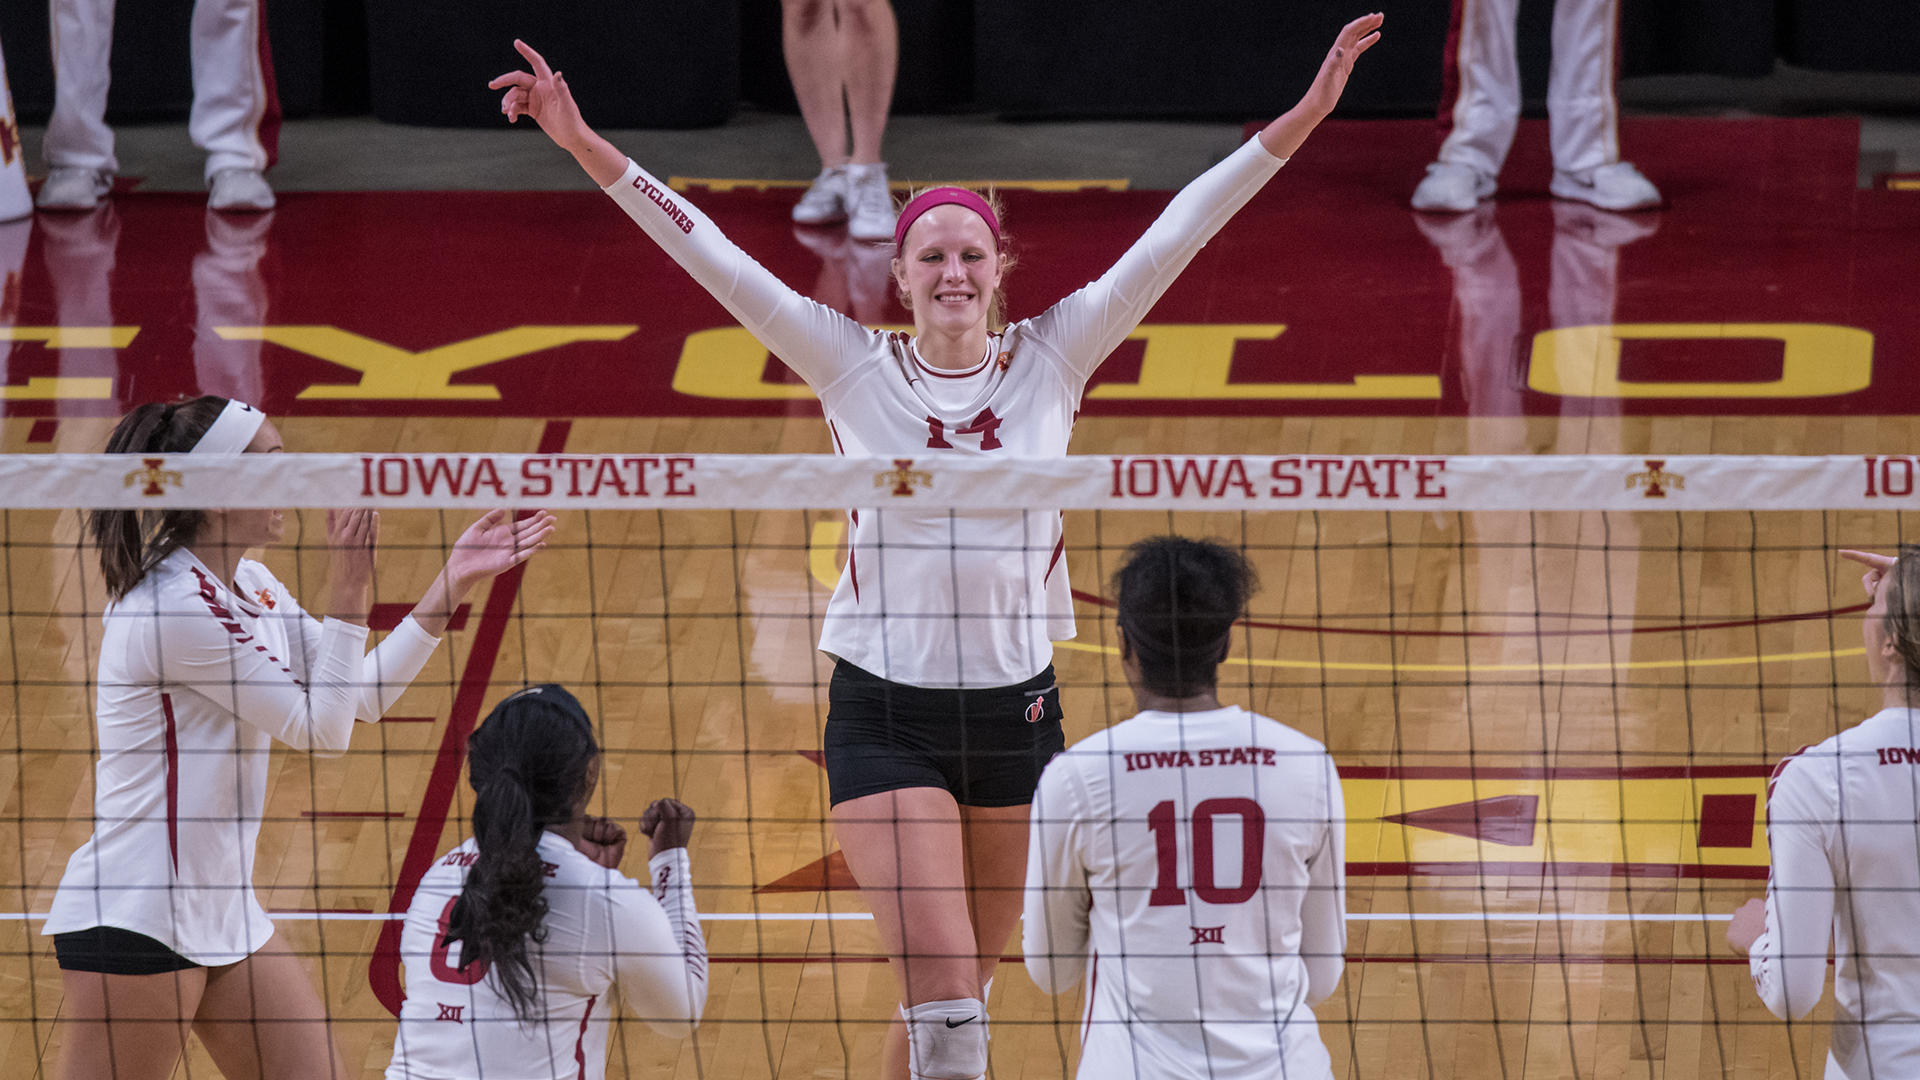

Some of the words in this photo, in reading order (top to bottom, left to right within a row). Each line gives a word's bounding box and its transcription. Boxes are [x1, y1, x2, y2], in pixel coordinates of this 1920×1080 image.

[632, 175, 695, 235] CYCLONES
[926, 406, 1004, 451] 14
[361, 458, 507, 497] IOWA
[521, 458, 696, 497] STATE
[1111, 459, 1257, 498] IOWA
[1270, 459, 1447, 498] STATE
[1864, 458, 1920, 498] IO
[1124, 751, 1194, 772] IOWA
[1199, 747, 1276, 767] STATE
[1148, 797, 1265, 907] 10
[1190, 925, 1226, 945] XII
[436, 1002, 465, 1025] XII
